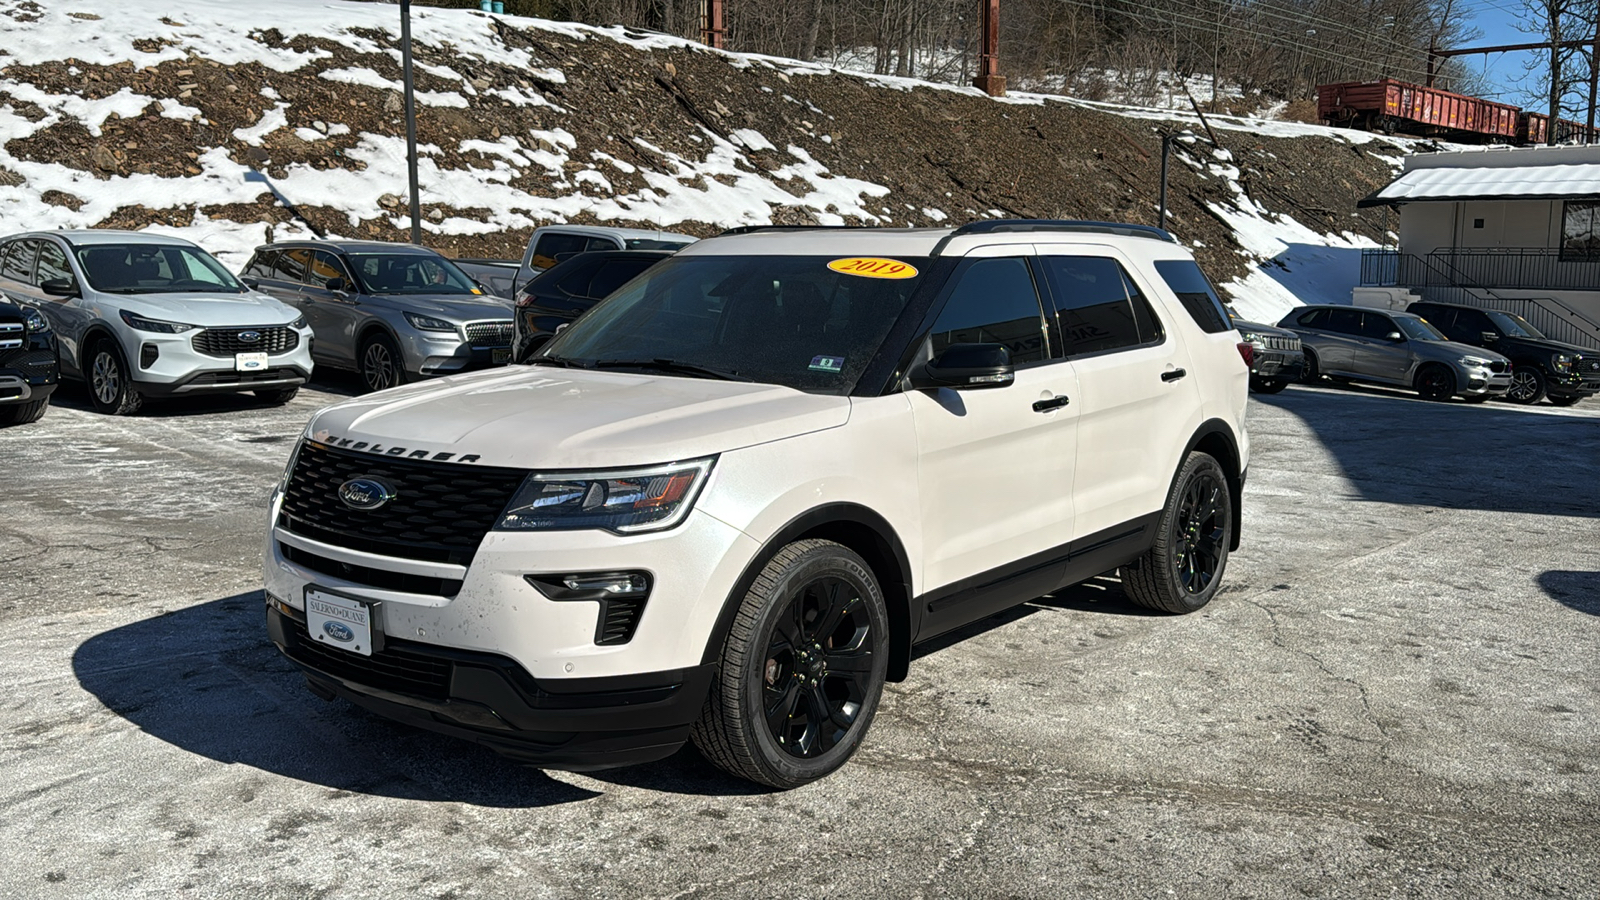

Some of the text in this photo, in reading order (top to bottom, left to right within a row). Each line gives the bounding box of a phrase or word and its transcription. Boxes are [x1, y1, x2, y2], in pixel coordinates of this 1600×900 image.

[840, 260, 906, 275] 2019
[324, 435, 482, 463] EXPLORER
[344, 482, 372, 503] Ford
[843, 560, 884, 616] TOURING
[310, 601, 366, 624] SALERNO DUANE
[329, 623, 349, 640] Ford
